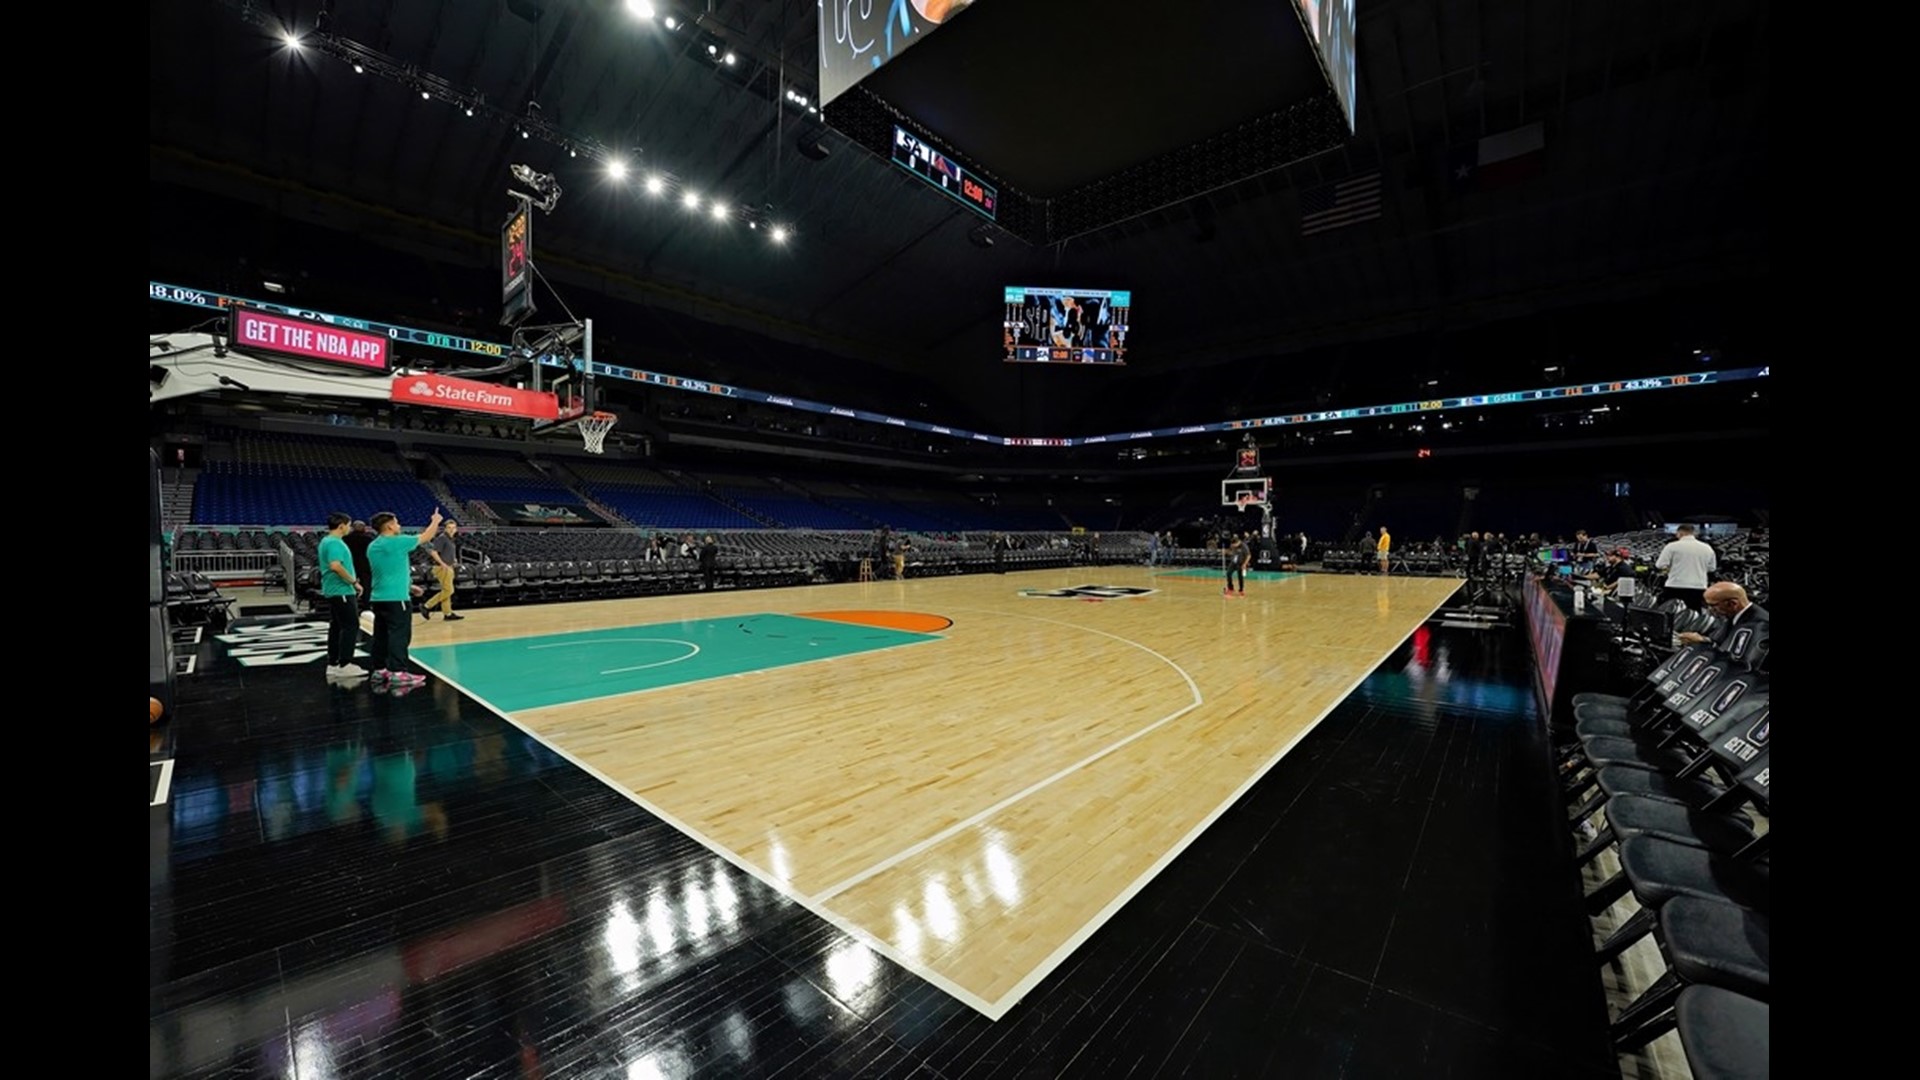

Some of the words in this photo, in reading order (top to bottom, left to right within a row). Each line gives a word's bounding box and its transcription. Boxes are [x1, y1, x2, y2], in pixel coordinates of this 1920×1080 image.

[389, 328, 398, 339] 0
[246, 319, 279, 344] GET
[282, 325, 313, 350] THE
[317, 333, 347, 356] NBA
[350, 339, 381, 362] APP
[470, 339, 501, 356] 12:00
[605, 367, 611, 375] 0
[1625, 378, 1662, 390] 43.3%
[1699, 374, 1708, 383] 7
[1535, 390, 1542, 398] 0
[1418, 448, 1431, 458] 24
